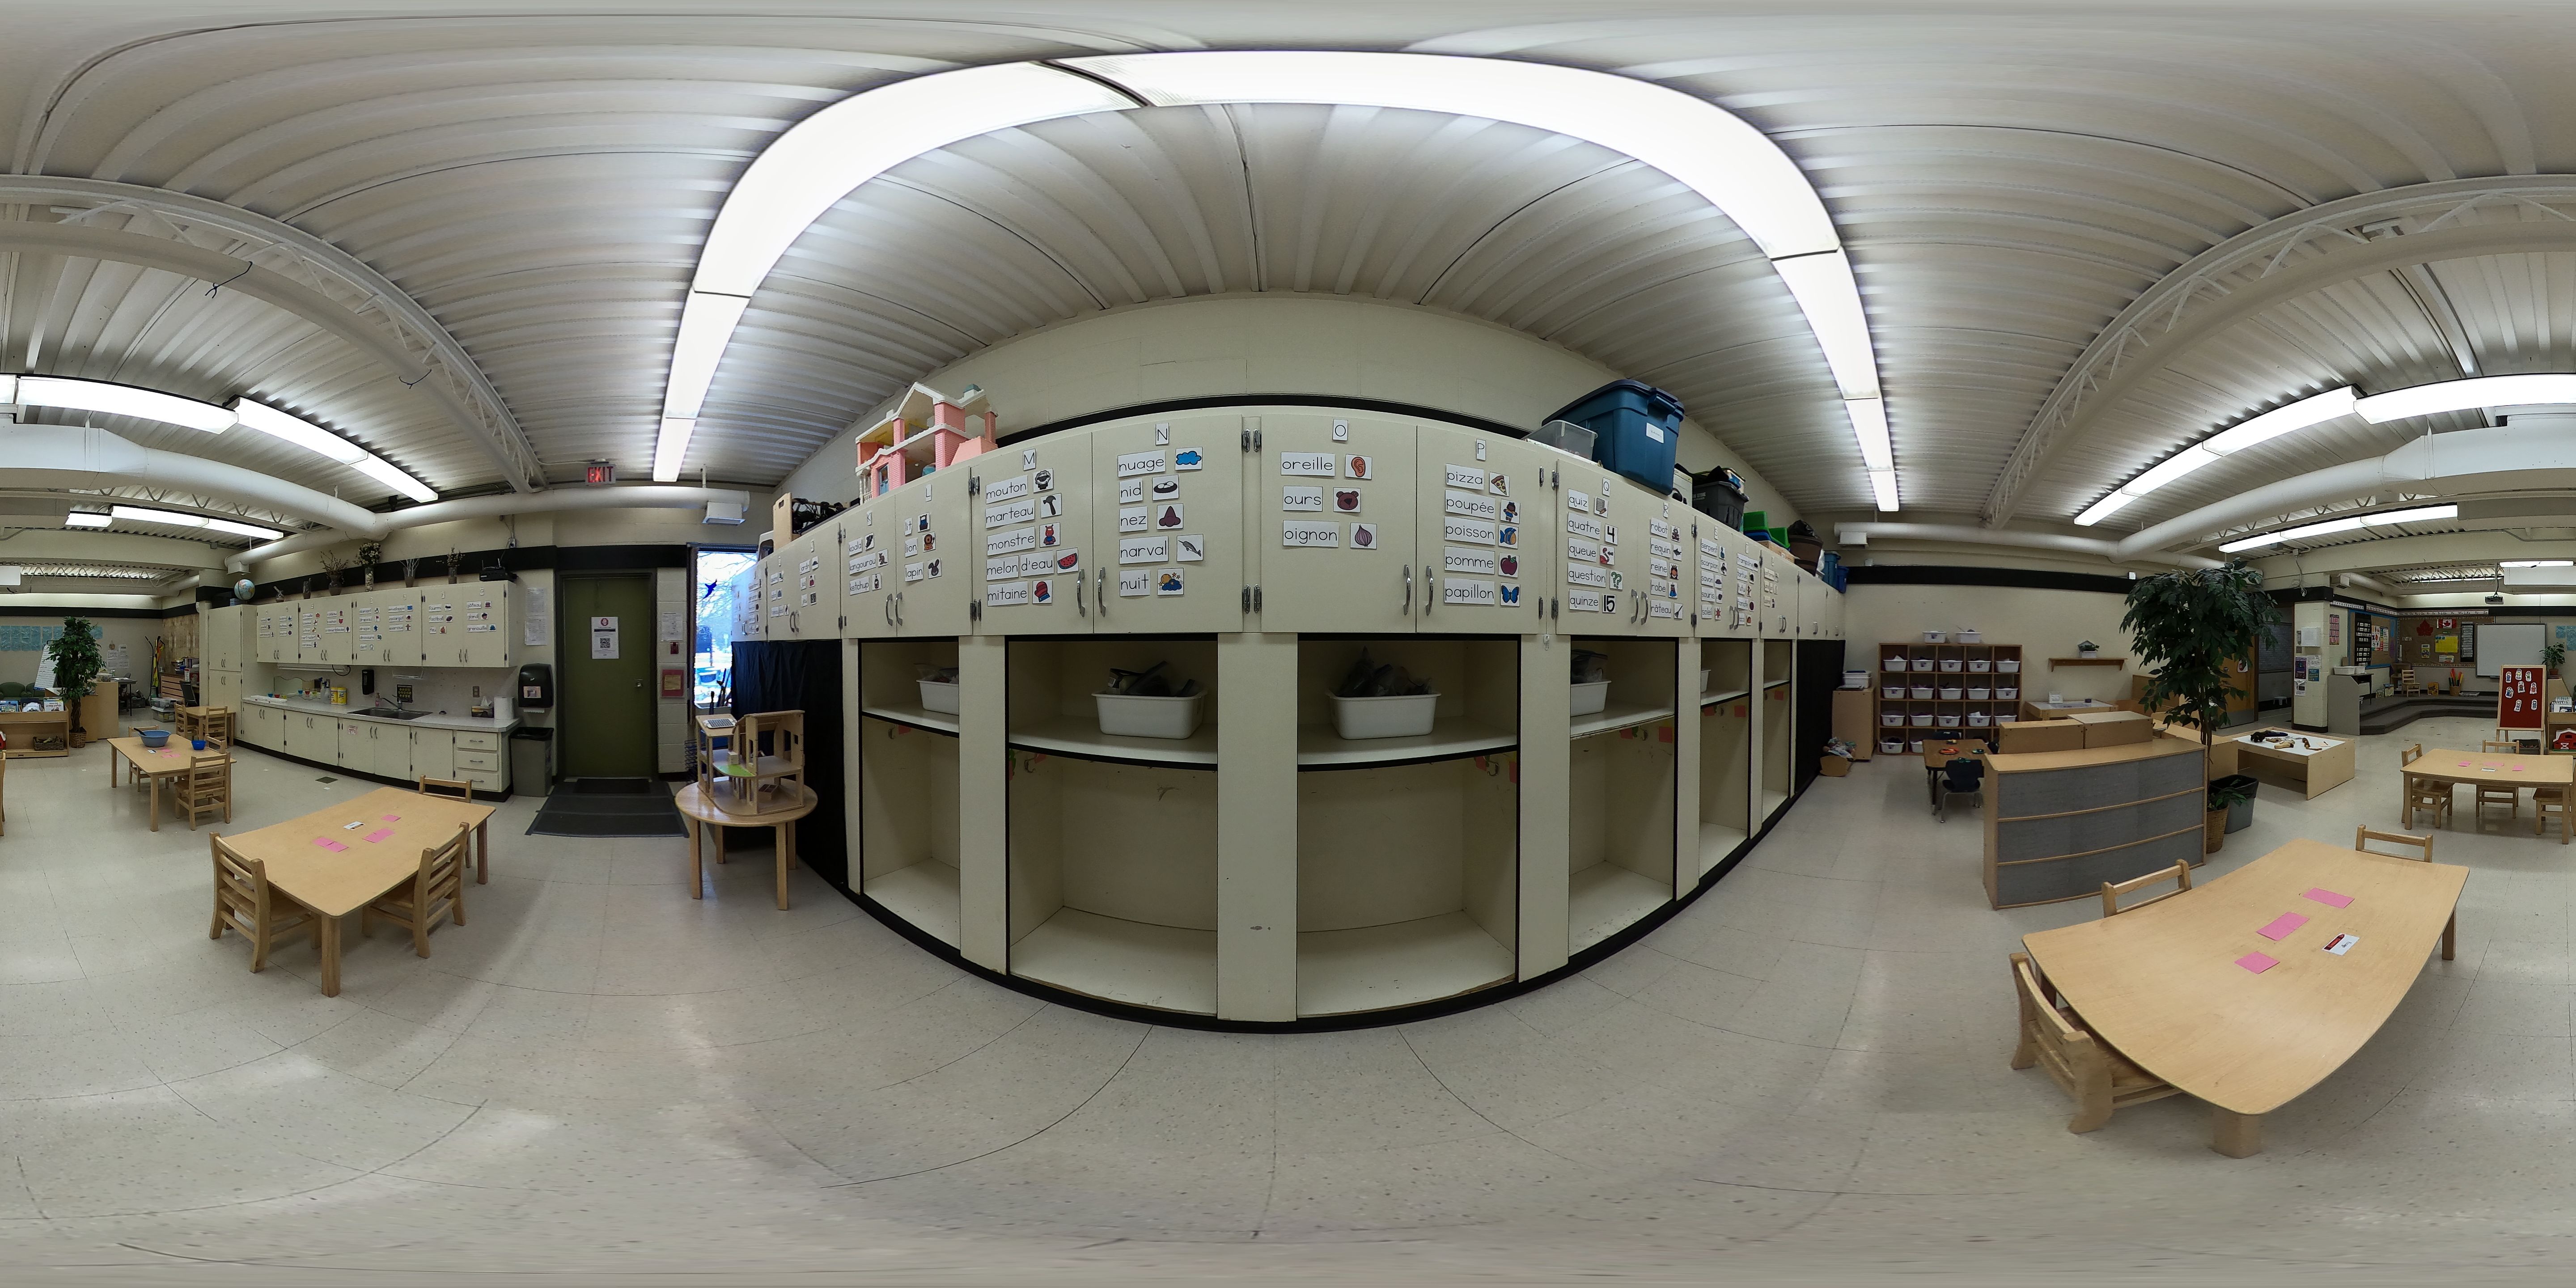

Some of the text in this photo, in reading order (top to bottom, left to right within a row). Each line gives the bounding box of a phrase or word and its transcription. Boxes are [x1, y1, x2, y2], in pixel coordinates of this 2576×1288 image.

[1157, 428, 1168, 441] N
[1335, 425, 1346, 437] O
[1477, 443, 1484, 454] P
[1024, 452, 1034, 466] M
[1119, 458, 1164, 473] nuage
[1282, 457, 1333, 471] oreille
[588, 466, 614, 483] EXIT
[1447, 472, 1483, 486] pizza
[987, 483, 1026, 498] mouton
[1121, 482, 1141, 498] nid
[1603, 481, 1609, 491] Q
[1284, 494, 1321, 505] ours
[1446, 497, 1494, 513] poupée
[1569, 496, 1588, 507] quiz
[986, 508, 1034, 523] marteau
[1664, 504, 1668, 514] R
[1121, 514, 1146, 526] nez
[1568, 519, 1600, 534] quatre
[1445, 525, 1494, 539] poisson
[1651, 523, 1668, 534] robot
[987, 534, 1034, 551] monstre
[1284, 528, 1337, 544] oignon
[905, 543, 916, 553] lion
[1120, 540, 1167, 558] narval
[1569, 545, 1596, 556] queue
[1651, 542, 1670, 554] requin
[987, 558, 1053, 575] melon d'eau
[1445, 555, 1494, 570] pomme
[1651, 564, 1667, 572] reine
[906, 567, 923, 579] lapin
[1568, 570, 1606, 584] question
[1121, 574, 1149, 590] nuit
[1651, 582, 1666, 592] robe
[987, 587, 1027, 601] mitaine
[1445, 586, 1494, 602] papillon
[1570, 597, 1598, 607] quinze
[1651, 604, 1671, 614] râteau
